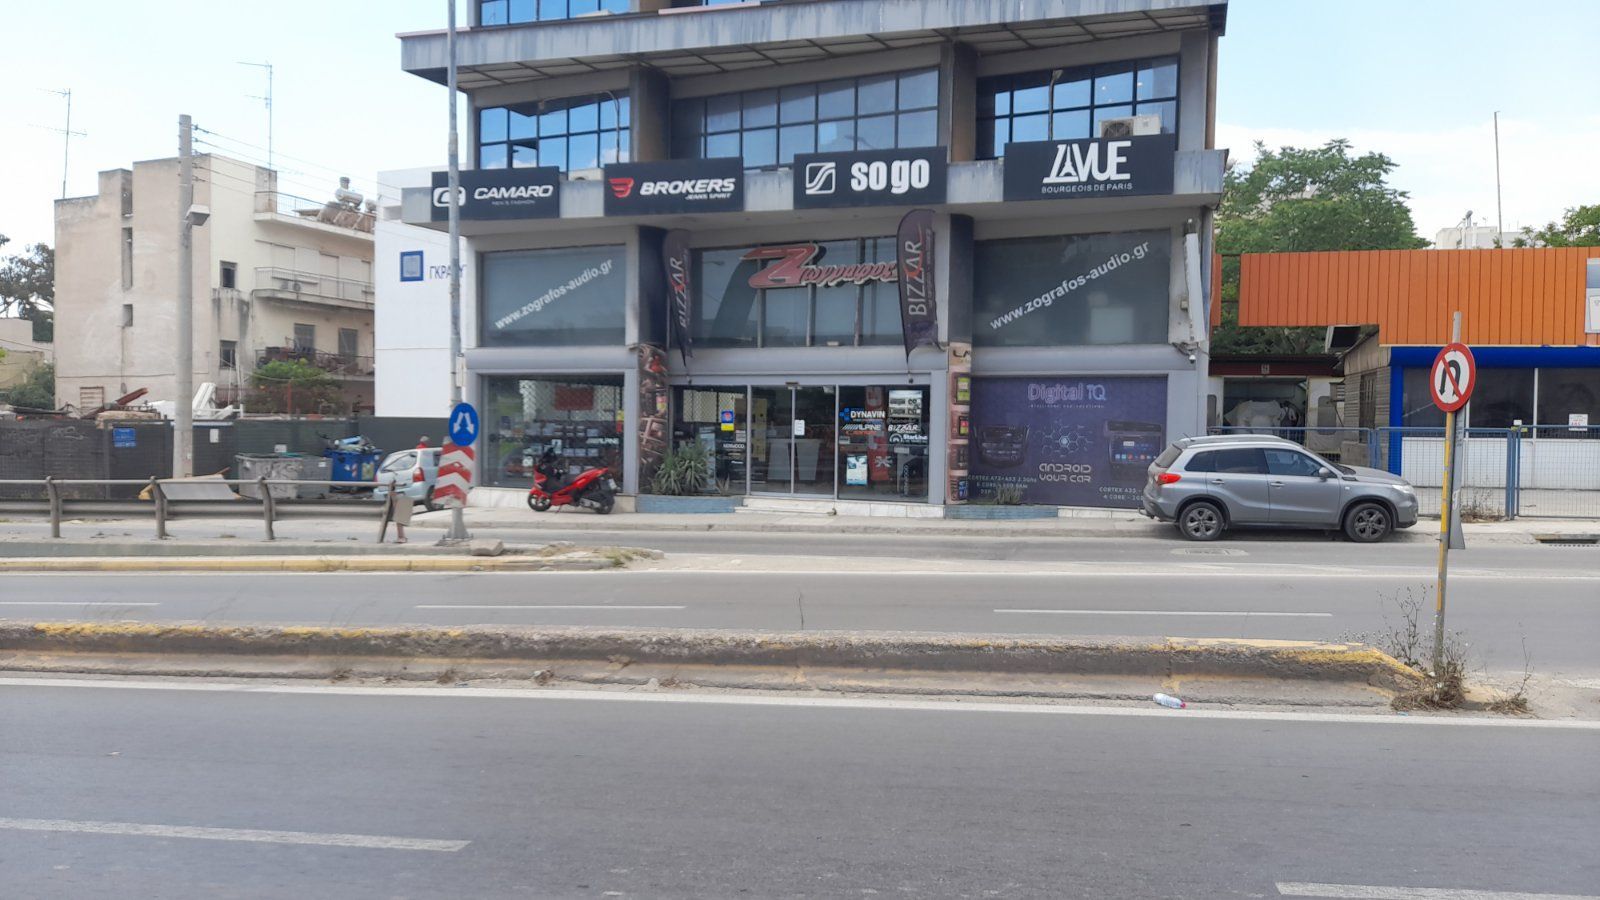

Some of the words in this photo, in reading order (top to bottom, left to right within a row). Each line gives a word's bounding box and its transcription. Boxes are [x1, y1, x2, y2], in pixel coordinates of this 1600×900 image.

[473, 184, 554, 200] CAMARO
[639, 177, 736, 196] BROKERS
[1041, 184, 1092, 194] BOURGEOIS
[1094, 183, 1105, 192] DE
[1106, 182, 1133, 192] PARIS
[904, 240, 927, 316] BIZZAR
[990, 240, 1150, 330] www.zografos-audio.gr
[495, 258, 613, 330] www.zografos-audio.gr
[669, 257, 688, 329] BIZZAR
[1027, 382, 1084, 404] Digital
[850, 410, 886, 418] DYNAVIN
[888, 424, 919, 432] BIZZAR
[1039, 463, 1092, 473] ANDROID
[1039, 473, 1067, 482] YOUR
[1069, 474, 1092, 483] CAR
[1099, 486, 1123, 494] CORTEX
